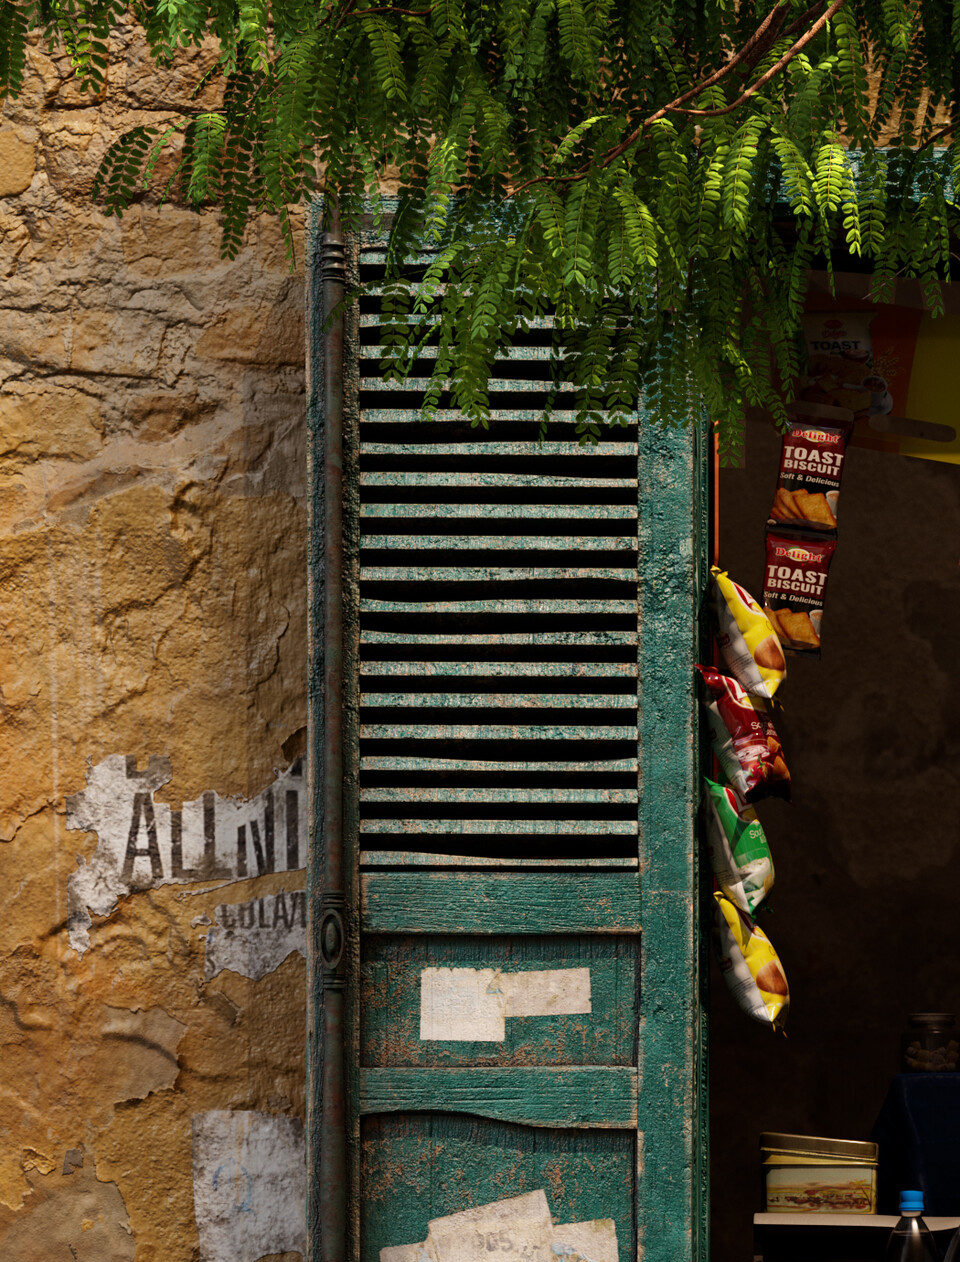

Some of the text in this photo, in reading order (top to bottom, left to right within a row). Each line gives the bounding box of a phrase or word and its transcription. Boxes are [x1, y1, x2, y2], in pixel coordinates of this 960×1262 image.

[813, 341, 860, 350] TOAST
[792, 429, 840, 445] Delight
[784, 446, 845, 467] TOAST
[783, 459, 840, 476] BISCUIT
[780, 471, 840, 488] Soft & Delicious
[775, 547, 823, 563] Delight
[768, 564, 828, 586] TOAST
[767, 577, 824, 596] BISCUIT
[763, 590, 823, 607] Soft & Delicious
